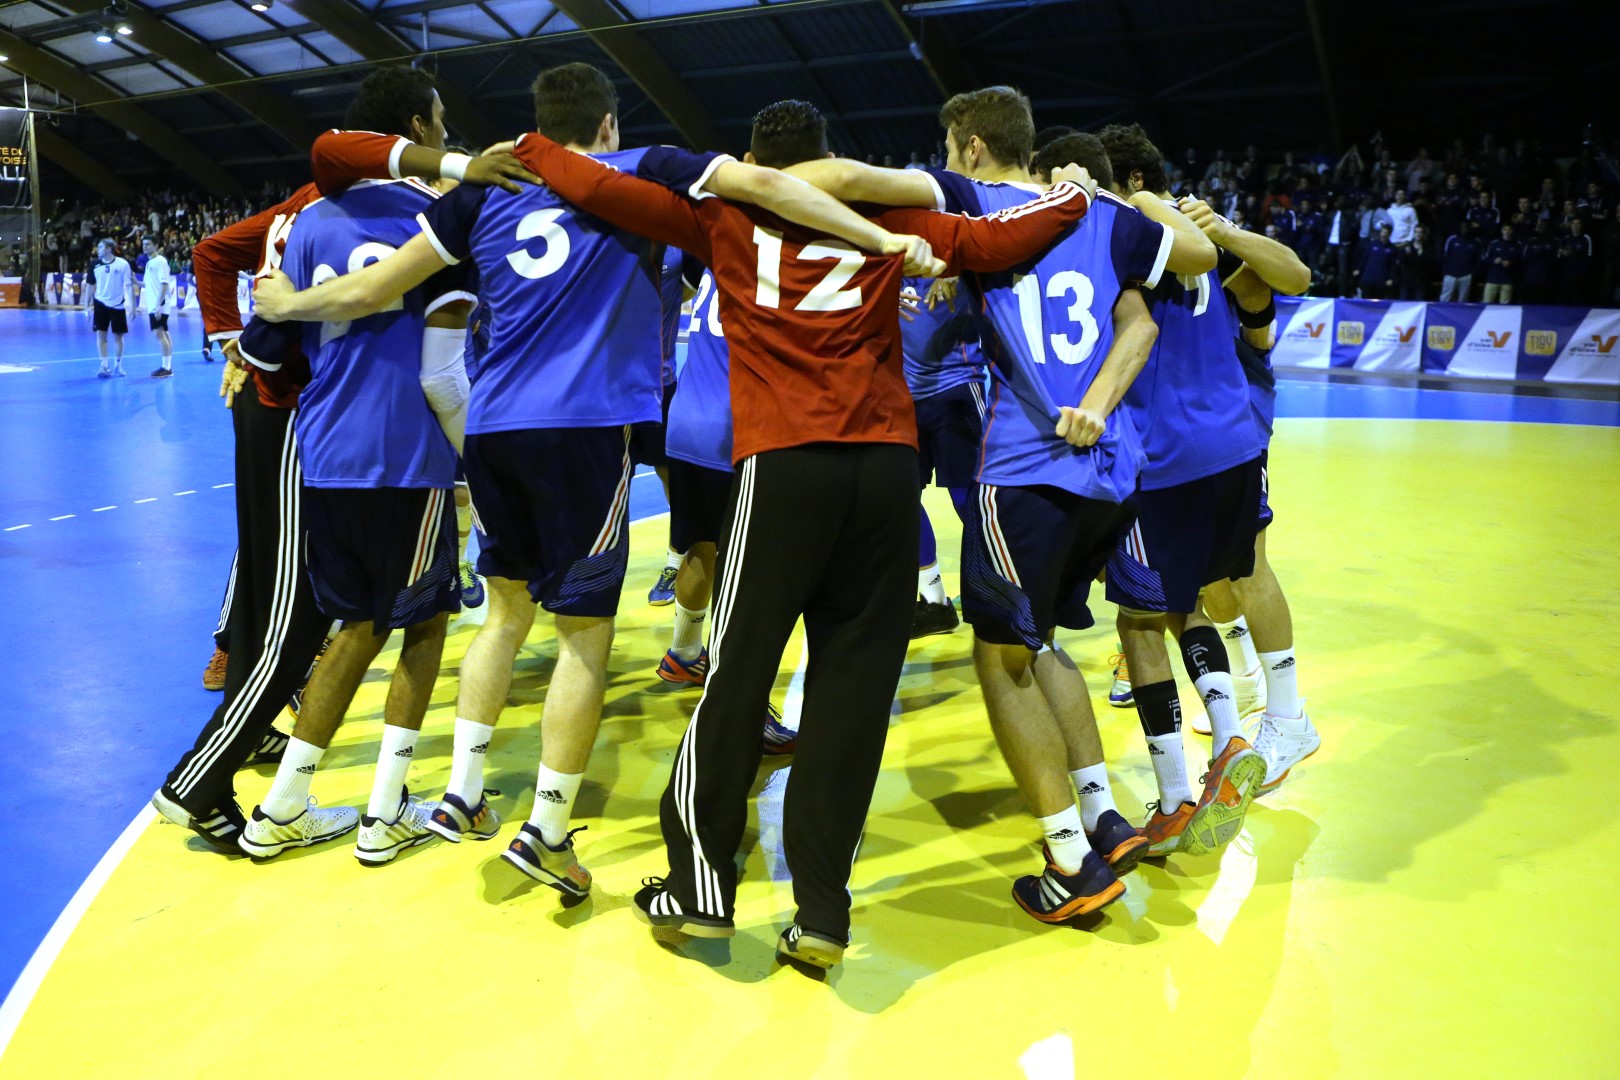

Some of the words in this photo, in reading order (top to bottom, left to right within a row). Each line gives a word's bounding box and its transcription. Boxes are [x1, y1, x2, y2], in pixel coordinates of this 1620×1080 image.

[753, 224, 867, 312] 12
[1012, 270, 1100, 365] 13
[1271, 660, 1295, 671] adida
[537, 791, 568, 804] adidas
[1048, 830, 1079, 840] adidas
